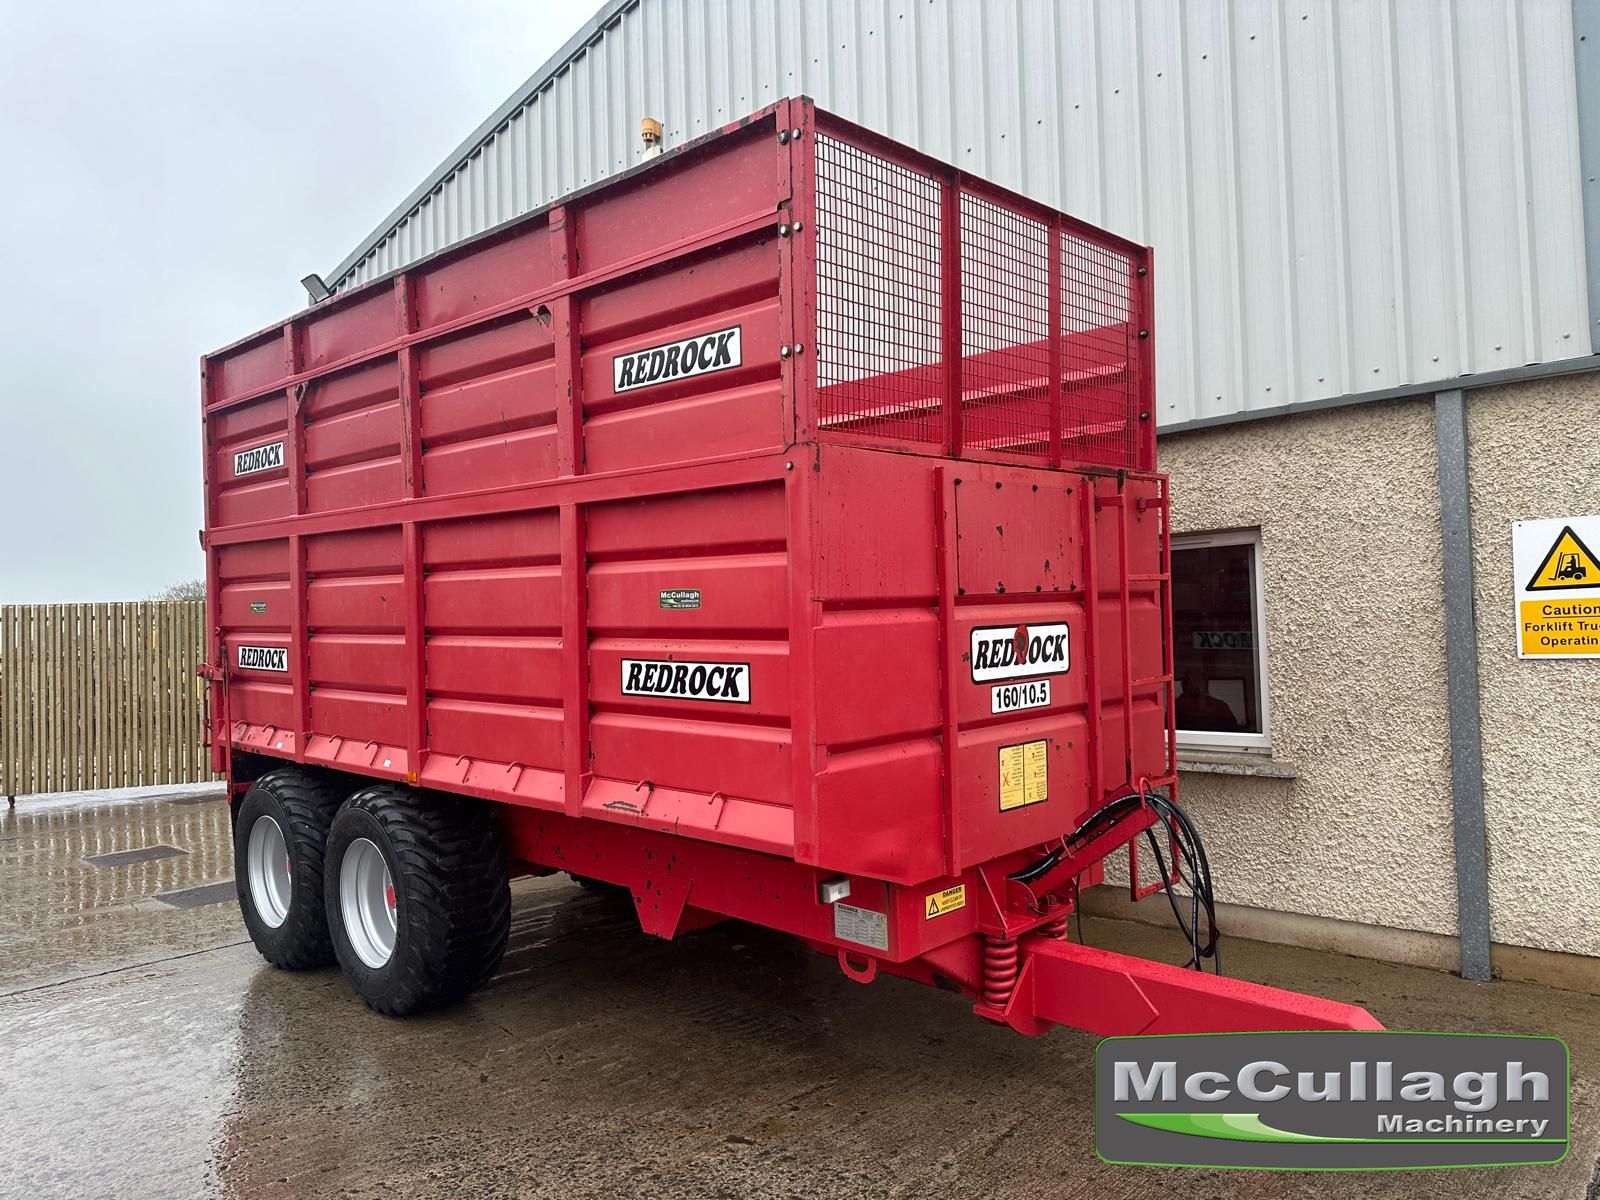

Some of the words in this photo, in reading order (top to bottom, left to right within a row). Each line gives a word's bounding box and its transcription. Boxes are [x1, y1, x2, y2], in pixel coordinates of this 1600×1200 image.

[618, 331, 735, 388] REDROCK
[236, 448, 281, 473] REDROCK
[661, 591, 699, 599] McCullagh
[1542, 604, 1600, 616] Caution
[1525, 621, 1573, 632] Forklift
[1577, 621, 1600, 631] Tru
[1540, 635, 1600, 647] Operatin
[240, 648, 285, 669] REDROCK
[626, 663, 743, 697] REDROCK
[996, 683, 1047, 709] 160/10.5
[943, 887, 962, 898] DANGER
